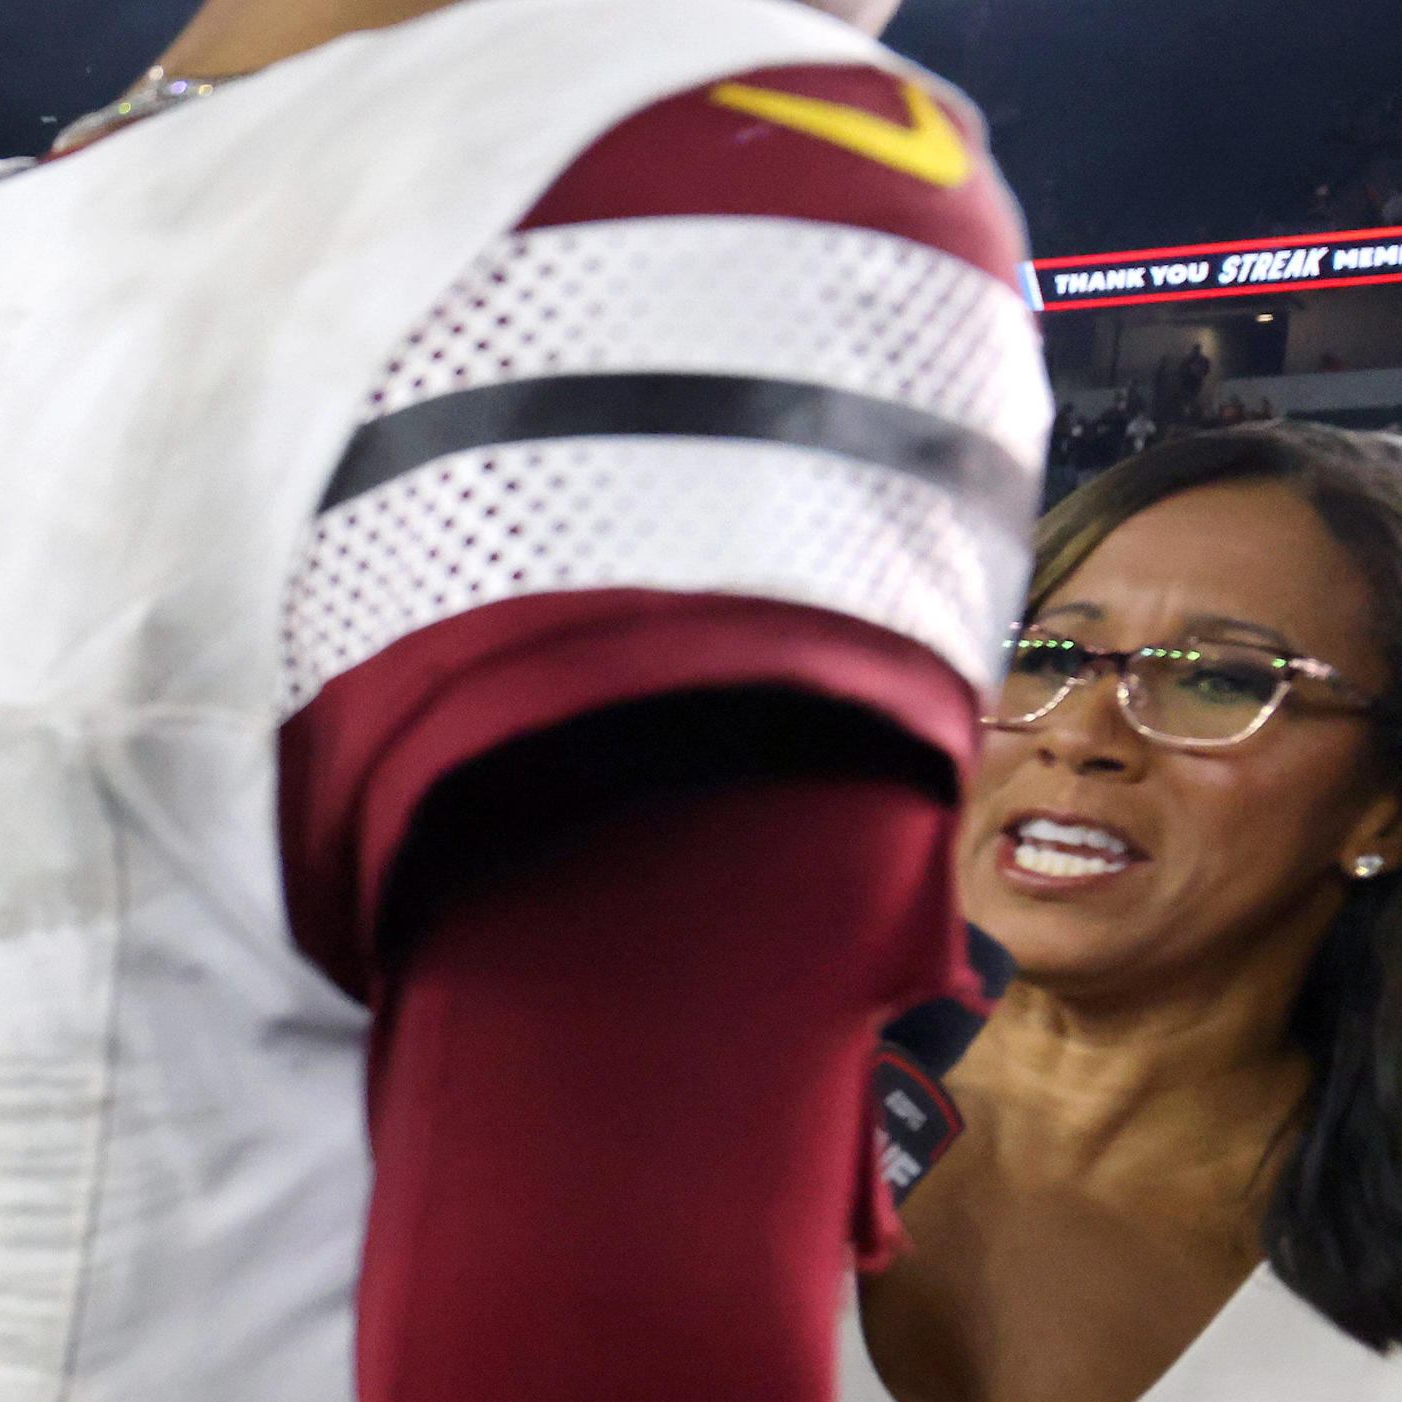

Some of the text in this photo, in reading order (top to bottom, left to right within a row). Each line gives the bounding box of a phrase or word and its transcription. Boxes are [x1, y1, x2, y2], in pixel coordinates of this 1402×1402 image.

[1053, 244, 1402, 296] THANK YOU STREAK MEM
